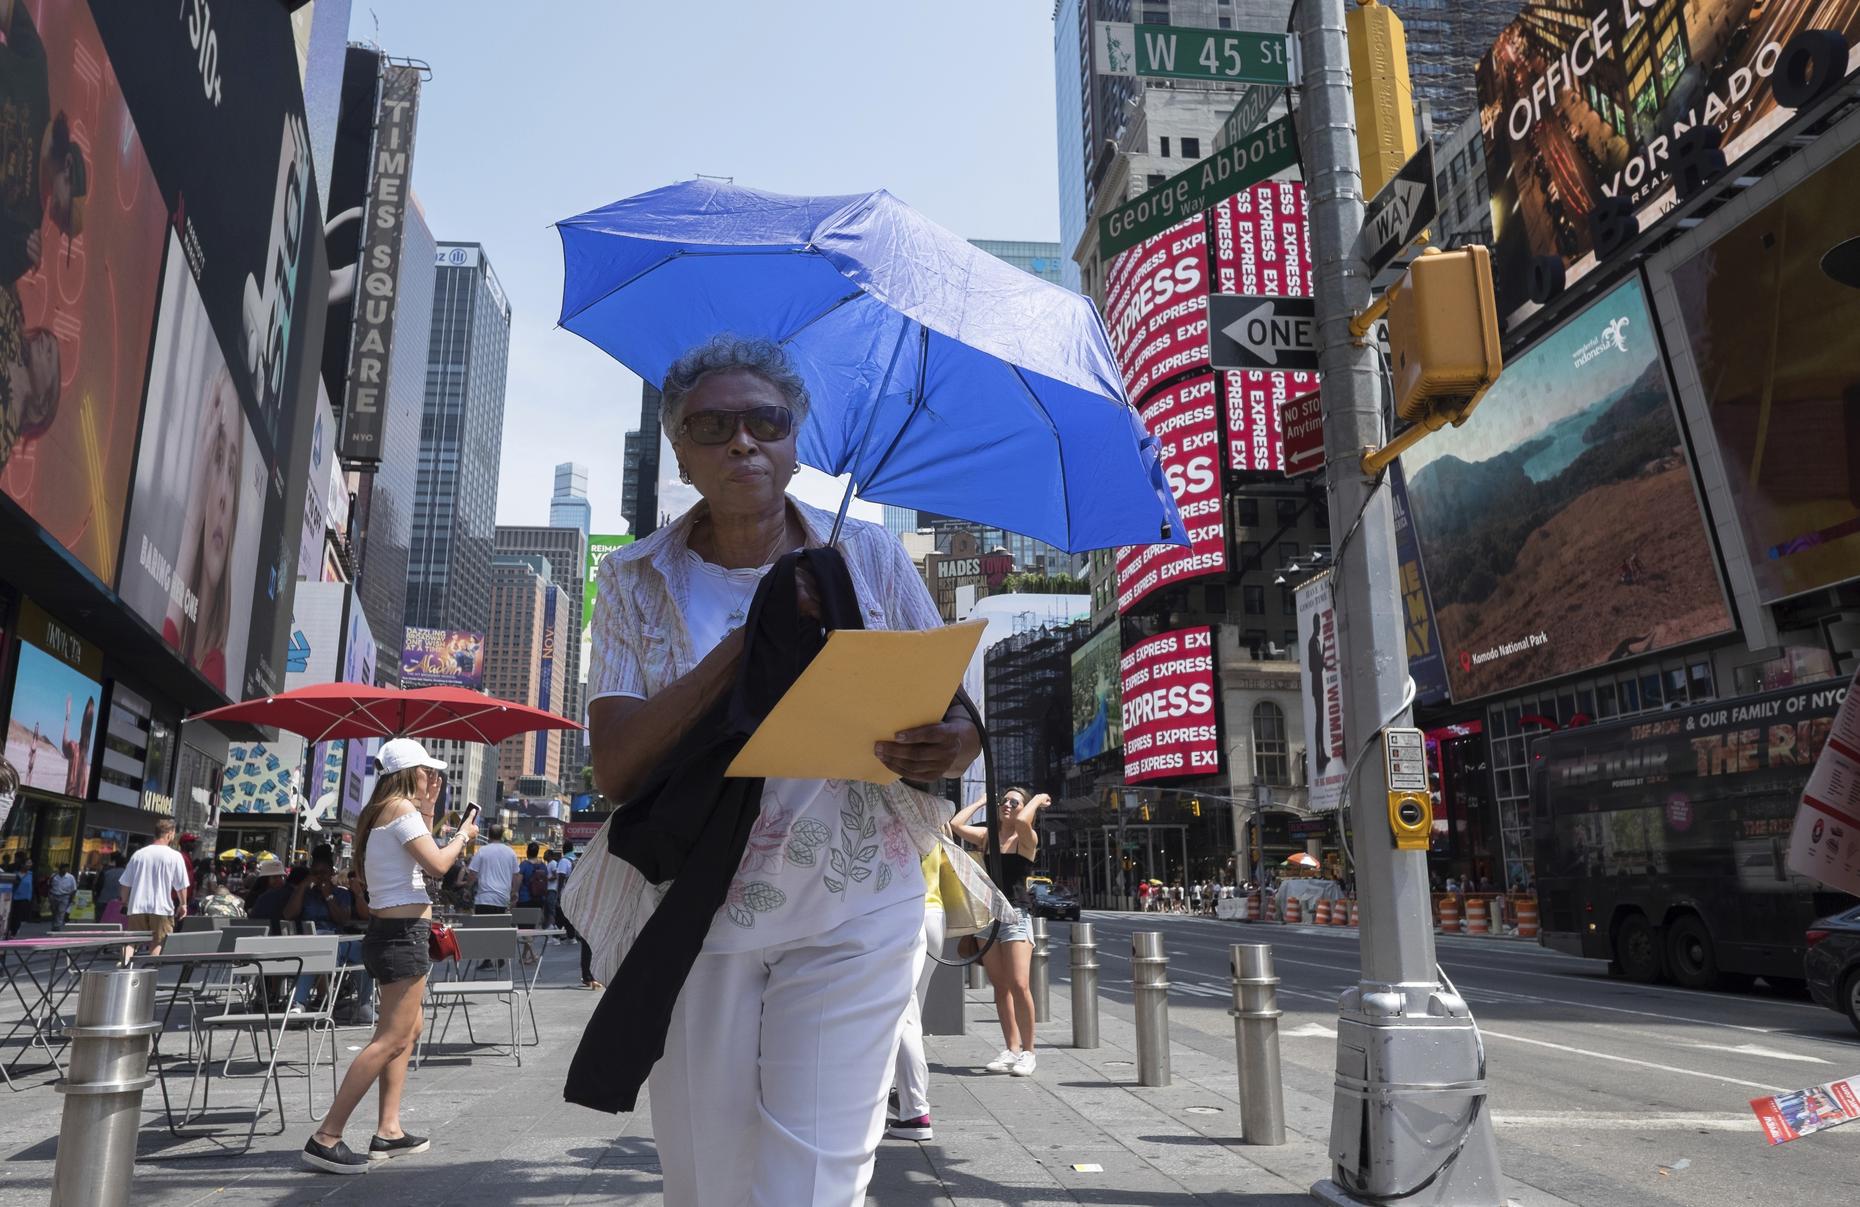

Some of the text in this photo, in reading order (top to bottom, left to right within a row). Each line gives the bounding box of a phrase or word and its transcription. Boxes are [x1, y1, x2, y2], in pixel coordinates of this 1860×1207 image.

[1145, 33, 1284, 76] W 45 St
[1508, 8, 1613, 141] OFFICE
[1601, 41, 1783, 199] VORNADO
[1631, 99, 1753, 204] REAL UST
[1109, 122, 1288, 238] George Abbott
[1258, 188, 1276, 262] EXPRESS
[1377, 187, 1412, 245] WAY
[355, 101, 411, 414] TIMES SQUARE
[1131, 249, 1167, 290] EXPRESS
[1239, 221, 1257, 295] EXPRESS
[1282, 223, 1301, 297] EXPRESS
[1109, 257, 1201, 356] EXPRESS
[1149, 295, 1208, 332] EXPRESS
[1134, 334, 1171, 372] EXPRESS
[1247, 318, 1313, 348] ONE
[1151, 344, 1209, 380] EXPRESS
[1154, 405, 1215, 437] EXPRESS
[1250, 390, 1269, 470] EXPRESS
[1285, 406, 1298, 423] NO
[352, 433, 374, 442] NYC
[1121, 555, 1142, 583] EXPRESS
[1133, 570, 1158, 598] EXPRESS
[1161, 551, 1224, 579] EXPRESS
[184, 588, 199, 624] ONE
[47, 622, 81, 665] INVICTA
[406, 627, 446, 637] DAZZLING
[406, 639, 422, 647] ONE
[1136, 637, 1177, 662] EXPRESS
[1321, 608, 1338, 675] PRETTY
[1472, 630, 1548, 665] Komodo National Park
[403, 654, 463, 676] Aladdin
[1125, 668, 1149, 691] EXPRESS
[1153, 655, 1213, 679] EXPRESS
[1122, 682, 1213, 732] EXPRESS
[1699, 712, 1728, 728] OUR
[1732, 701, 1780, 723] FAMILY
[1786, 696, 1806, 713] OF
[1812, 688, 1848, 710] NYC
[1128, 734, 1152, 755] EXPRESS
[1156, 725, 1216, 746] EXPRESS
[1690, 727, 1760, 777] THE
[1141, 753, 1183, 774] EXPRESS
